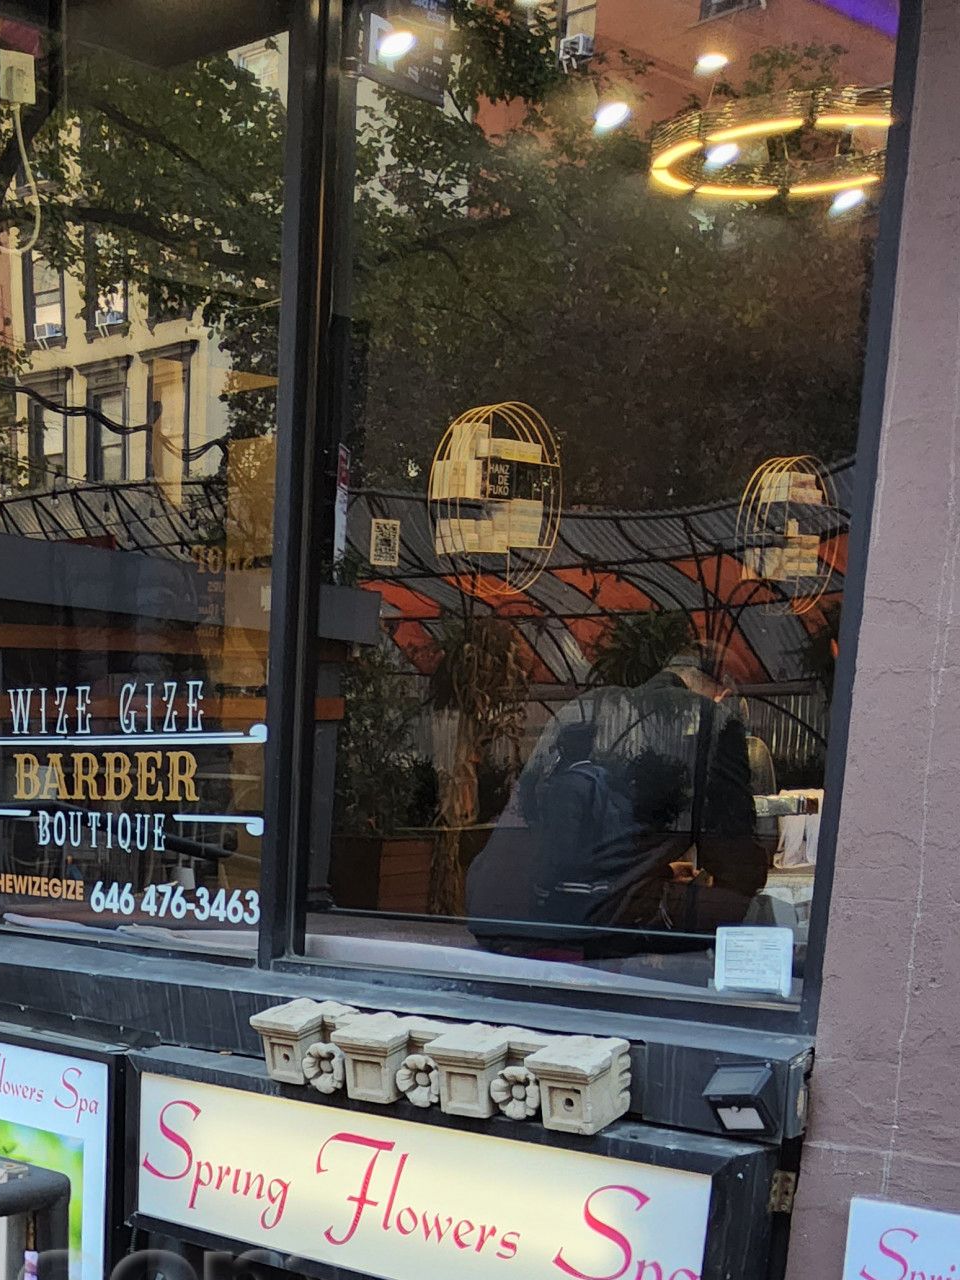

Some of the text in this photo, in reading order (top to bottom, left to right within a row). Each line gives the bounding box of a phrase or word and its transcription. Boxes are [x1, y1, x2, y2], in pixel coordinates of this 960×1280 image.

[7, 679, 205, 735] WIZE GIZE
[12, 750, 201, 803] BARBER
[36, 810, 168, 854] BOUTIQUE
[89, 880, 261, 925] 646 476-3463
[52, 1066, 100, 1123] Spa
[139, 1100, 290, 1227] Spring
[316, 1132, 520, 1260] Flowers
